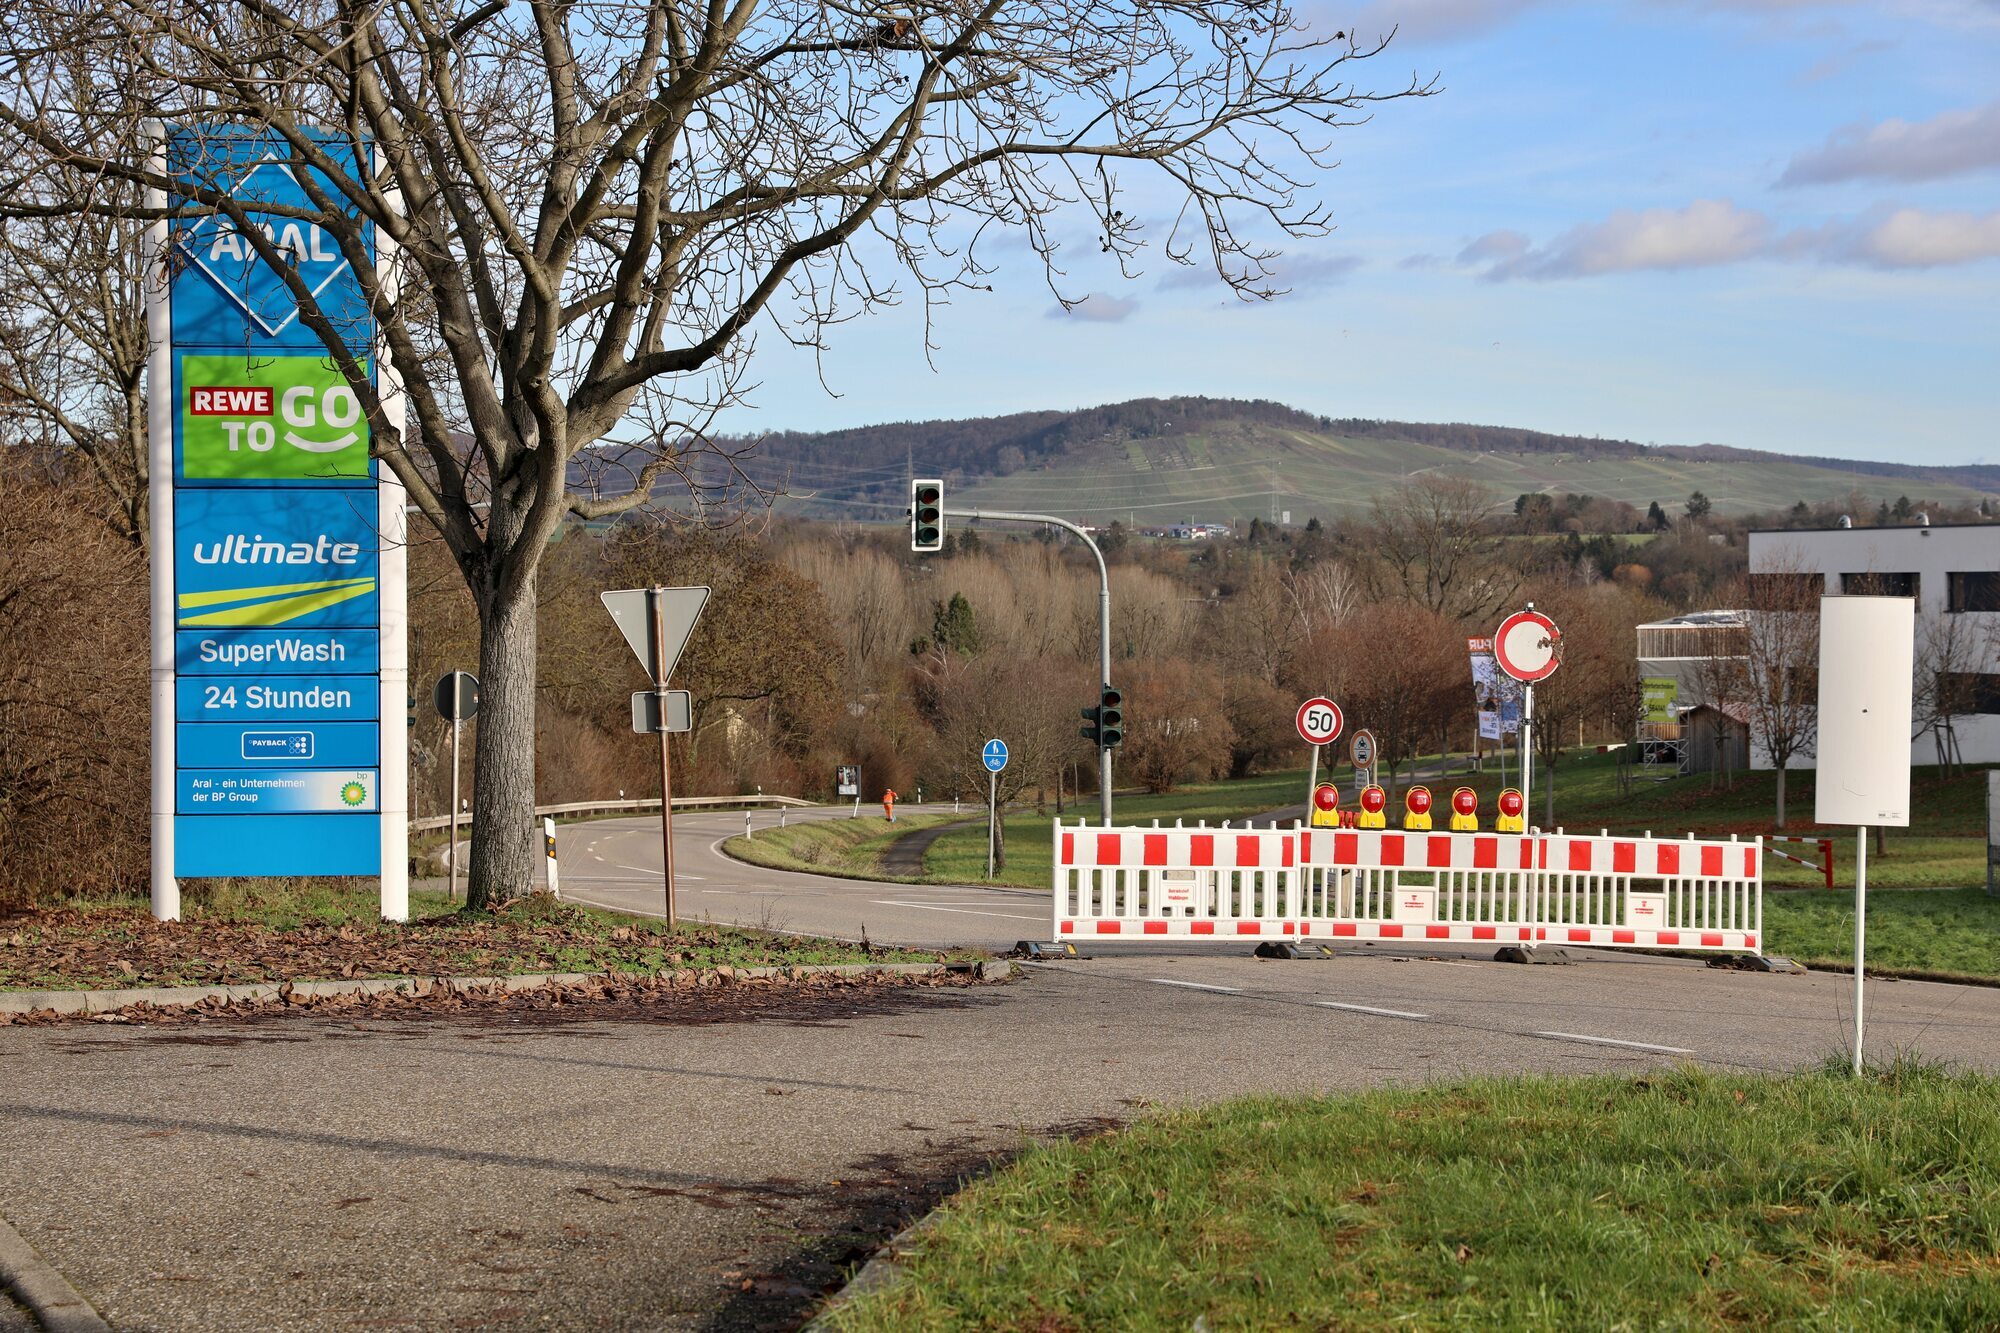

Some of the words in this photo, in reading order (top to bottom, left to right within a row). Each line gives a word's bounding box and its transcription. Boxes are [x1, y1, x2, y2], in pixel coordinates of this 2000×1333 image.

[194, 391, 269, 412] REWE
[281, 386, 360, 428] GO
[221, 422, 275, 452] TO
[193, 534, 359, 564] ultimate
[199, 639, 345, 667] SuperWash
[204, 686, 237, 709] 24
[245, 685, 351, 708] Stunden
[1307, 710, 1333, 733] 50
[192, 779, 212, 788] Aral
[222, 779, 237, 788] ein
[240, 779, 305, 788] Unternehmen
[356, 771, 368, 780] bp
[192, 793, 208, 802] der
[211, 793, 226, 802] BP
[228, 793, 258, 803] Group
